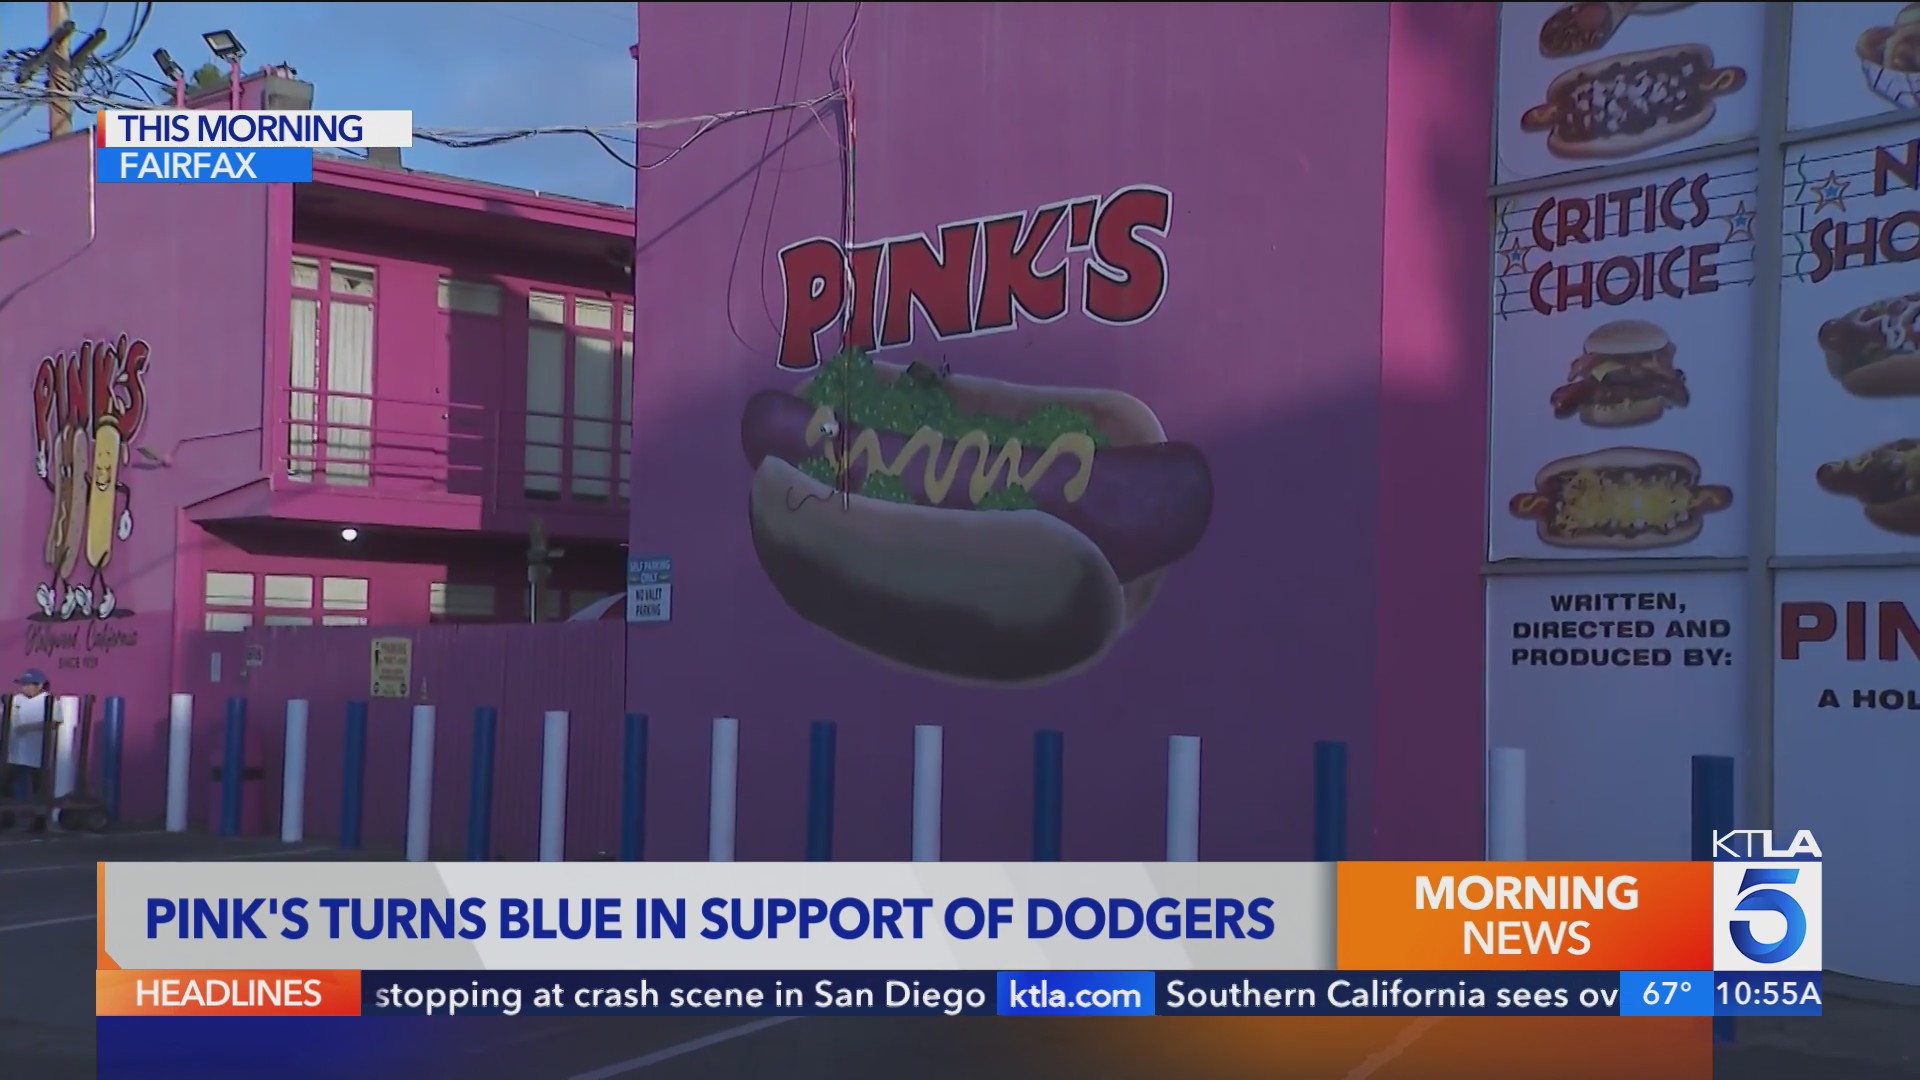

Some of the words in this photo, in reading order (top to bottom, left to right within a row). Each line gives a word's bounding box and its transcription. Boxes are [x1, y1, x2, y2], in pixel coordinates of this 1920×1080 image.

[1532, 173, 1709, 252] CRITICS
[777, 184, 1173, 371] PINK'S
[1529, 243, 1720, 316] CHOICE
[1810, 210, 1920, 283] SHO
[34, 332, 151, 452] PINK'S
[1512, 620, 1655, 639] DIRECTED
[1665, 619, 1731, 638] AND
[1550, 592, 1686, 613] WRITTEN,
[1781, 600, 1920, 662] PIN
[1511, 647, 1672, 667] PRODUCED
[1683, 647, 1733, 667] BY:
[1817, 689, 1841, 708] A
